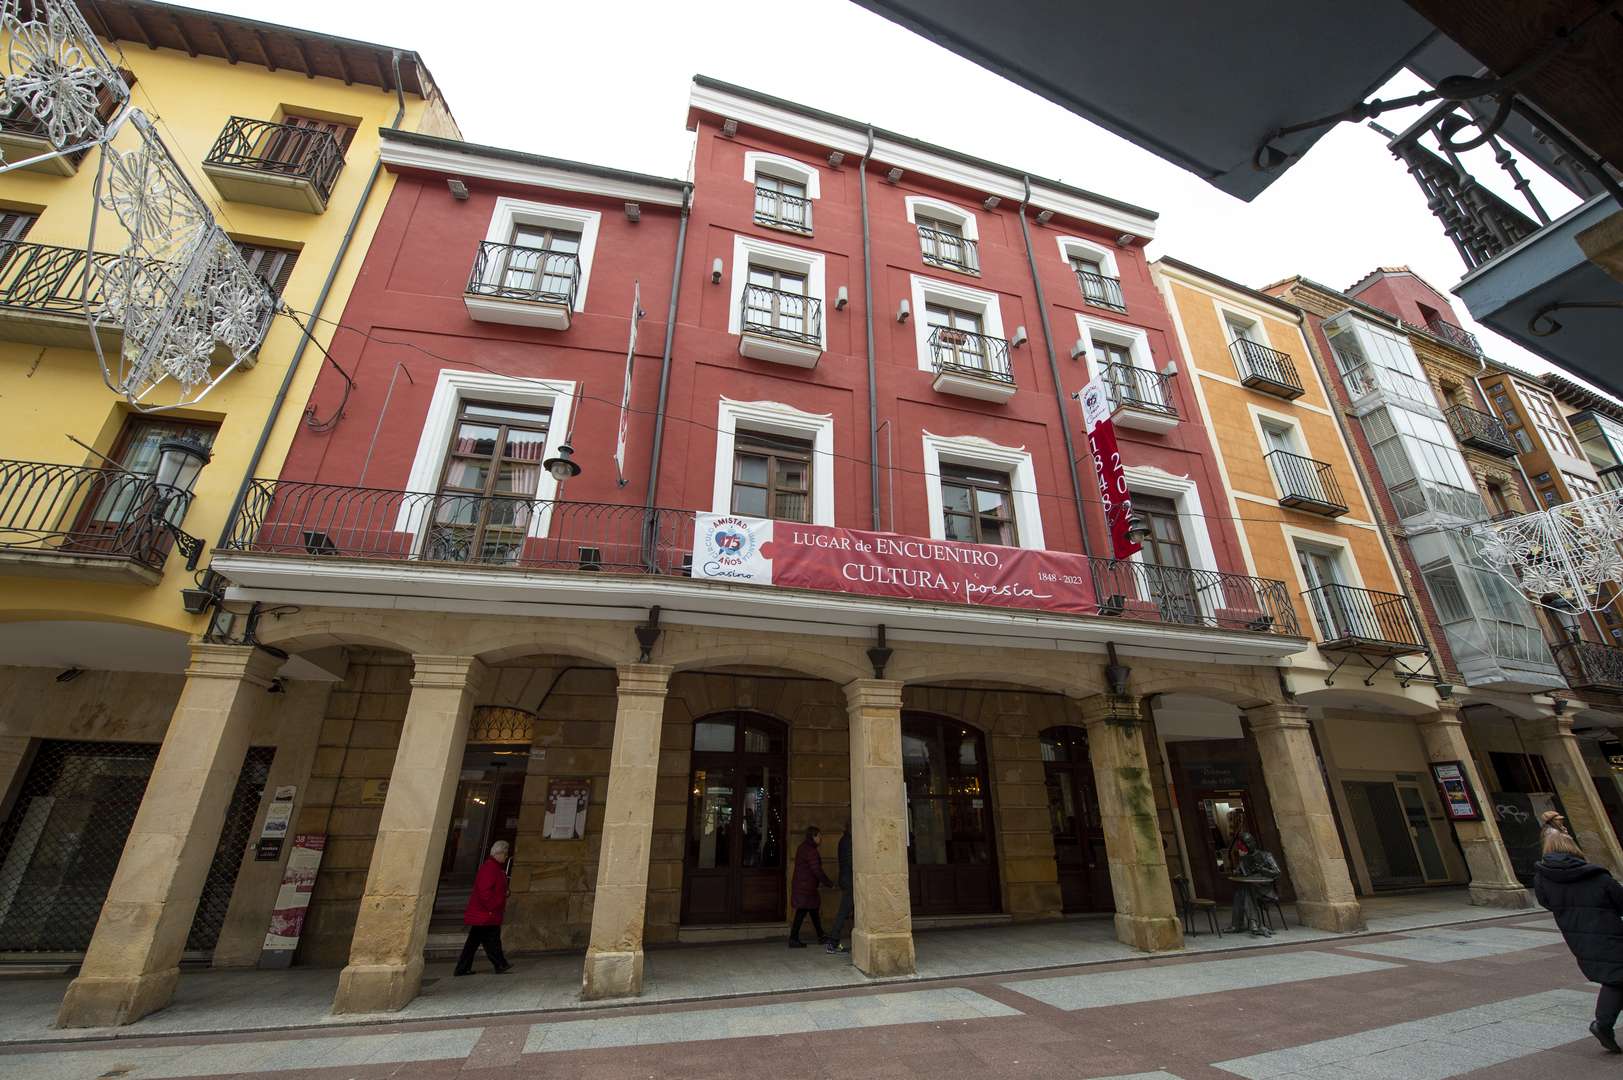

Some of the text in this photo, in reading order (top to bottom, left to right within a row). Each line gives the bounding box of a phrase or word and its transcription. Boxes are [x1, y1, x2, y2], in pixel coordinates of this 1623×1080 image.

[1111, 452, 1138, 545] 202
[713, 517, 748, 530] AMISTAD
[793, 531, 1003, 570] LUGAR de ENCUENTRO,
[703, 561, 754, 579] Casino
[719, 556, 742, 566] AÑOS
[842, 562, 950, 590] CULTURA
[952, 581, 960, 593] y
[1038, 572, 1057, 582] 1848
[1063, 575, 1083, 585] 2023
